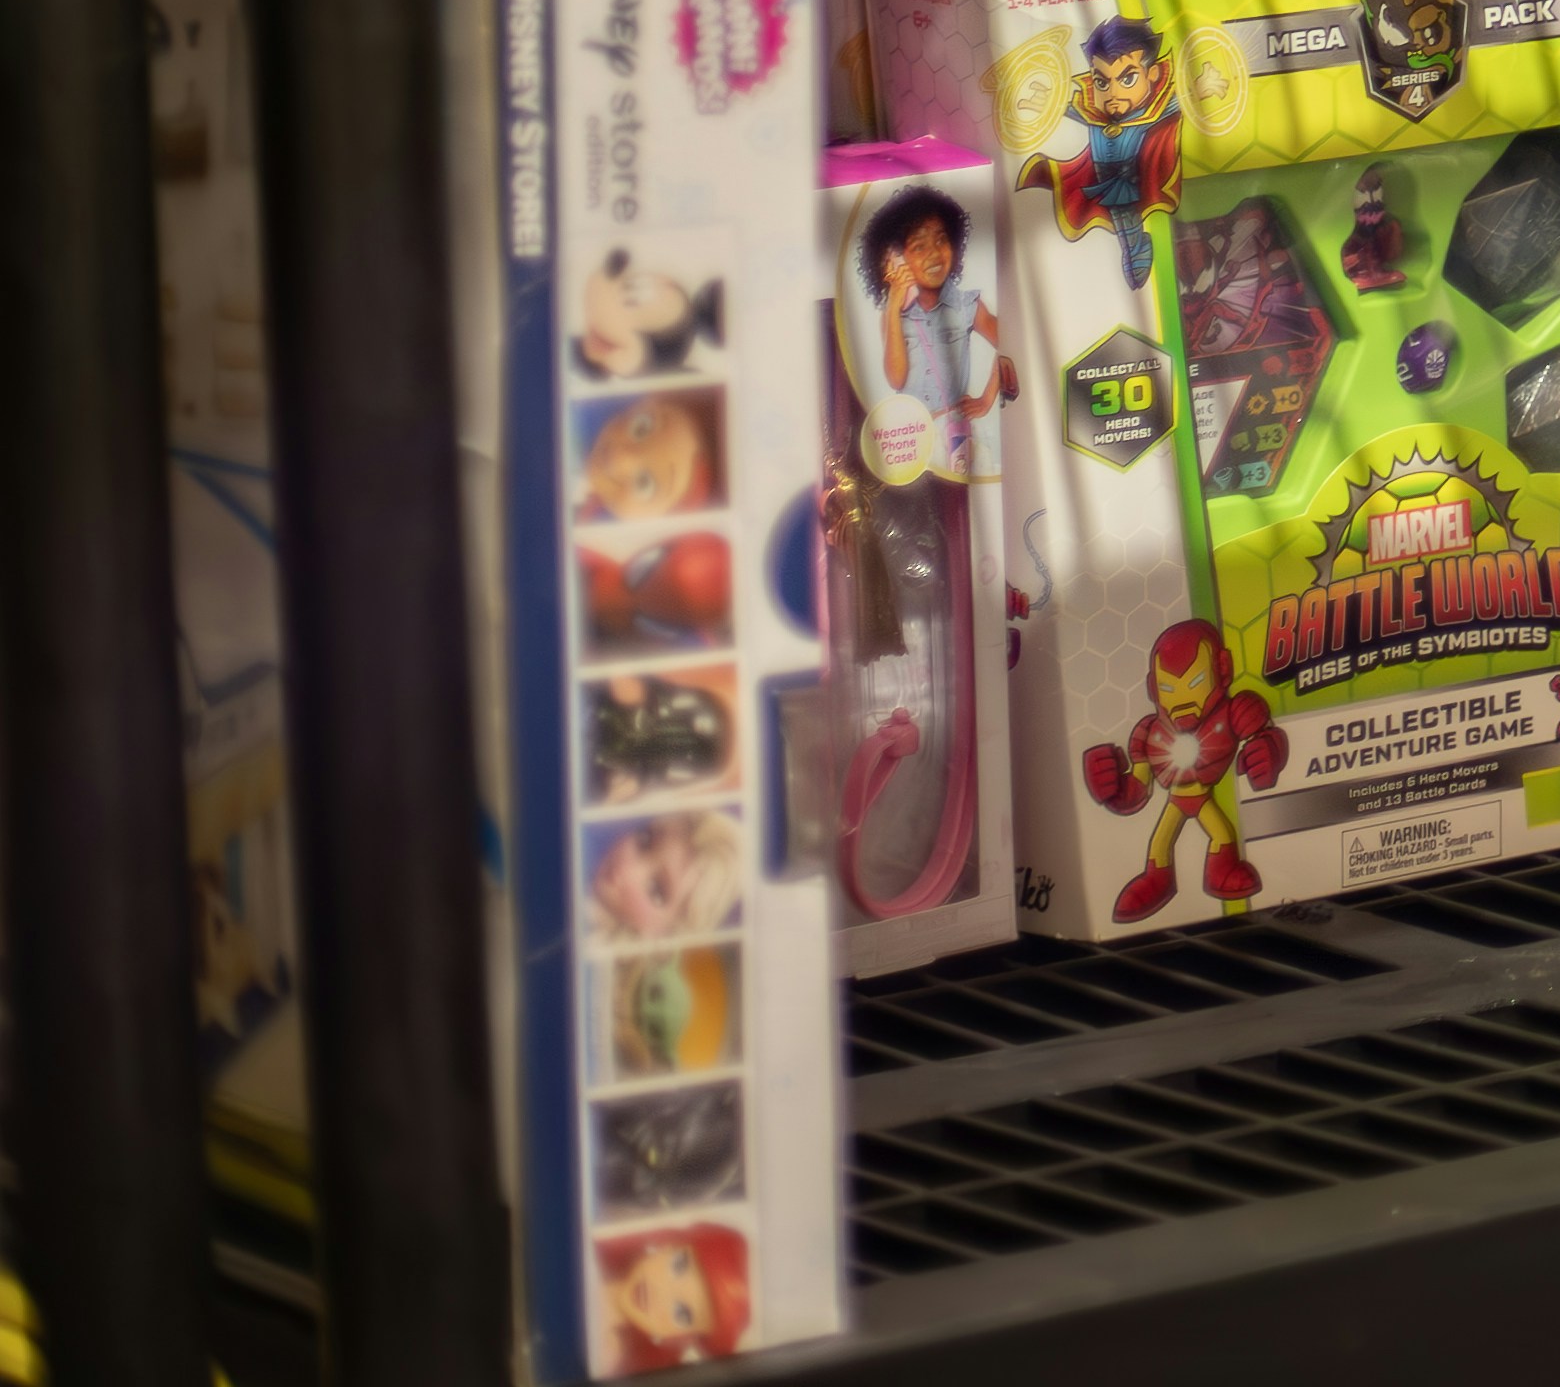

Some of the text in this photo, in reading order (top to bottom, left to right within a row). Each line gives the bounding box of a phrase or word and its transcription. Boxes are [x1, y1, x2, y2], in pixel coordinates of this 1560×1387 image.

[1267, 25, 1347, 60] MEGA
[1391, 71, 1440, 88] SERIES
[1408, 87, 1425, 108] 4
[610, 92, 640, 225] store
[511, 116, 545, 259] STORE!
[1076, 358, 1162, 382] COLLECT ALL
[1090, 375, 1153, 418] 30
[872, 421, 927, 441] Wearable
[1093, 427, 1152, 446] MOVERS!
[1105, 416, 1141, 431] HERO
[880, 437, 917, 453] Phone
[885, 449, 917, 466] Case!
[1369, 501, 1472, 563] MARVEL
[1298, 625, 1549, 690] RISE OF THE SYMBIOTES
[1325, 689, 1522, 748] COLLECTIBLE
[1305, 716, 1534, 778] ADVENTURE GAME
[1348, 761, 1499, 799] Includes 6 Hero Movers
[1357, 778, 1487, 812] and Battle Cards
[1379, 818, 1452, 847] WARNING:
[1348, 838, 1438, 868] CHOKING HAZARD
